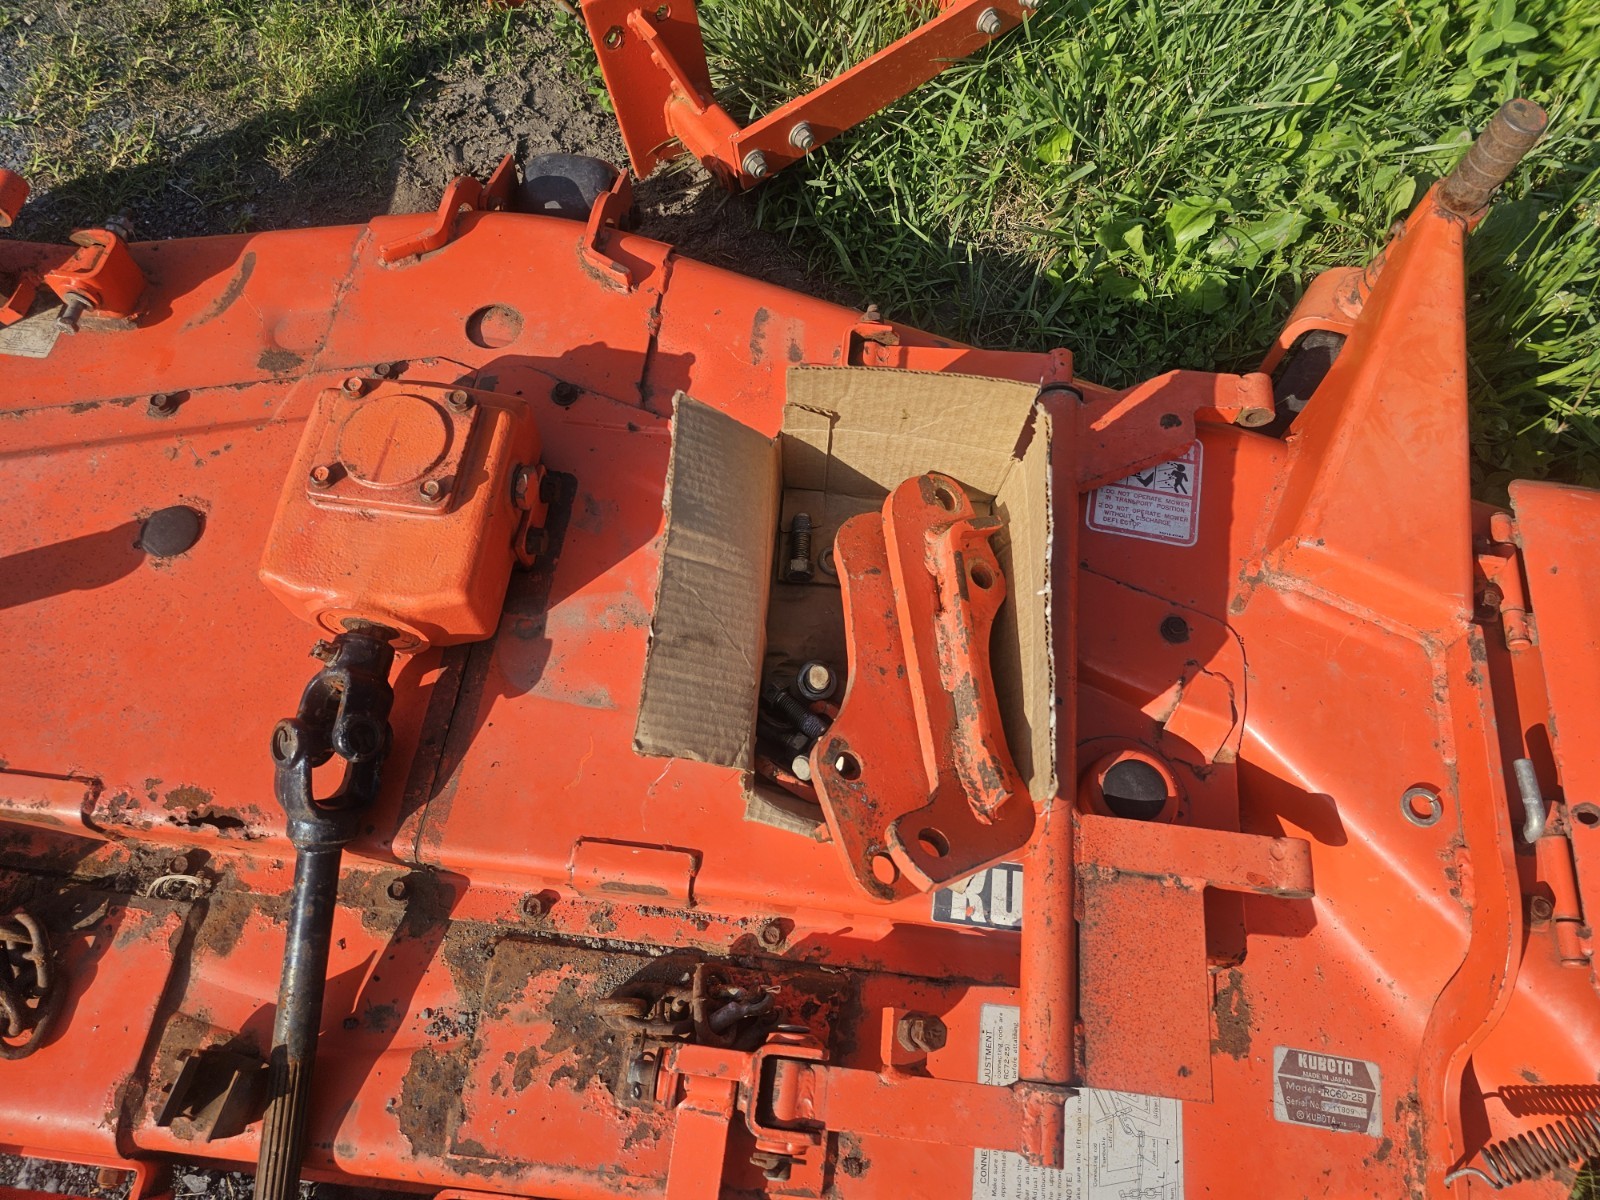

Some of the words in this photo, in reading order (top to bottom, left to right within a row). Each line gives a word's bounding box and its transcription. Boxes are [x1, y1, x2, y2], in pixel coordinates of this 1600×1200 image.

[1115, 496, 1153, 508] TRANSPORT
[1156, 503, 1186, 513] POSITION
[1133, 493, 1162, 503] OPERATE
[1165, 498, 1190, 508] MOWER
[1103, 509, 1132, 519] WITHOUT
[1132, 508, 1161, 518] OPERATE
[1164, 513, 1189, 523] MOWER
[1298, 1053, 1353, 1076] KUBOTA
[1302, 1070, 1321, 1080] MADE
[1321, 1073, 1329, 1081] IN
[1331, 1076, 1352, 1085] JAPAN
[1285, 1081, 1316, 1094] Model
[979, 1150, 988, 1184] CONNE
[984, 1030, 993, 1086] DJUSTMENT
[1286, 1096, 1308, 1107] Serial
[1306, 1111, 1336, 1124] KUBOTA
